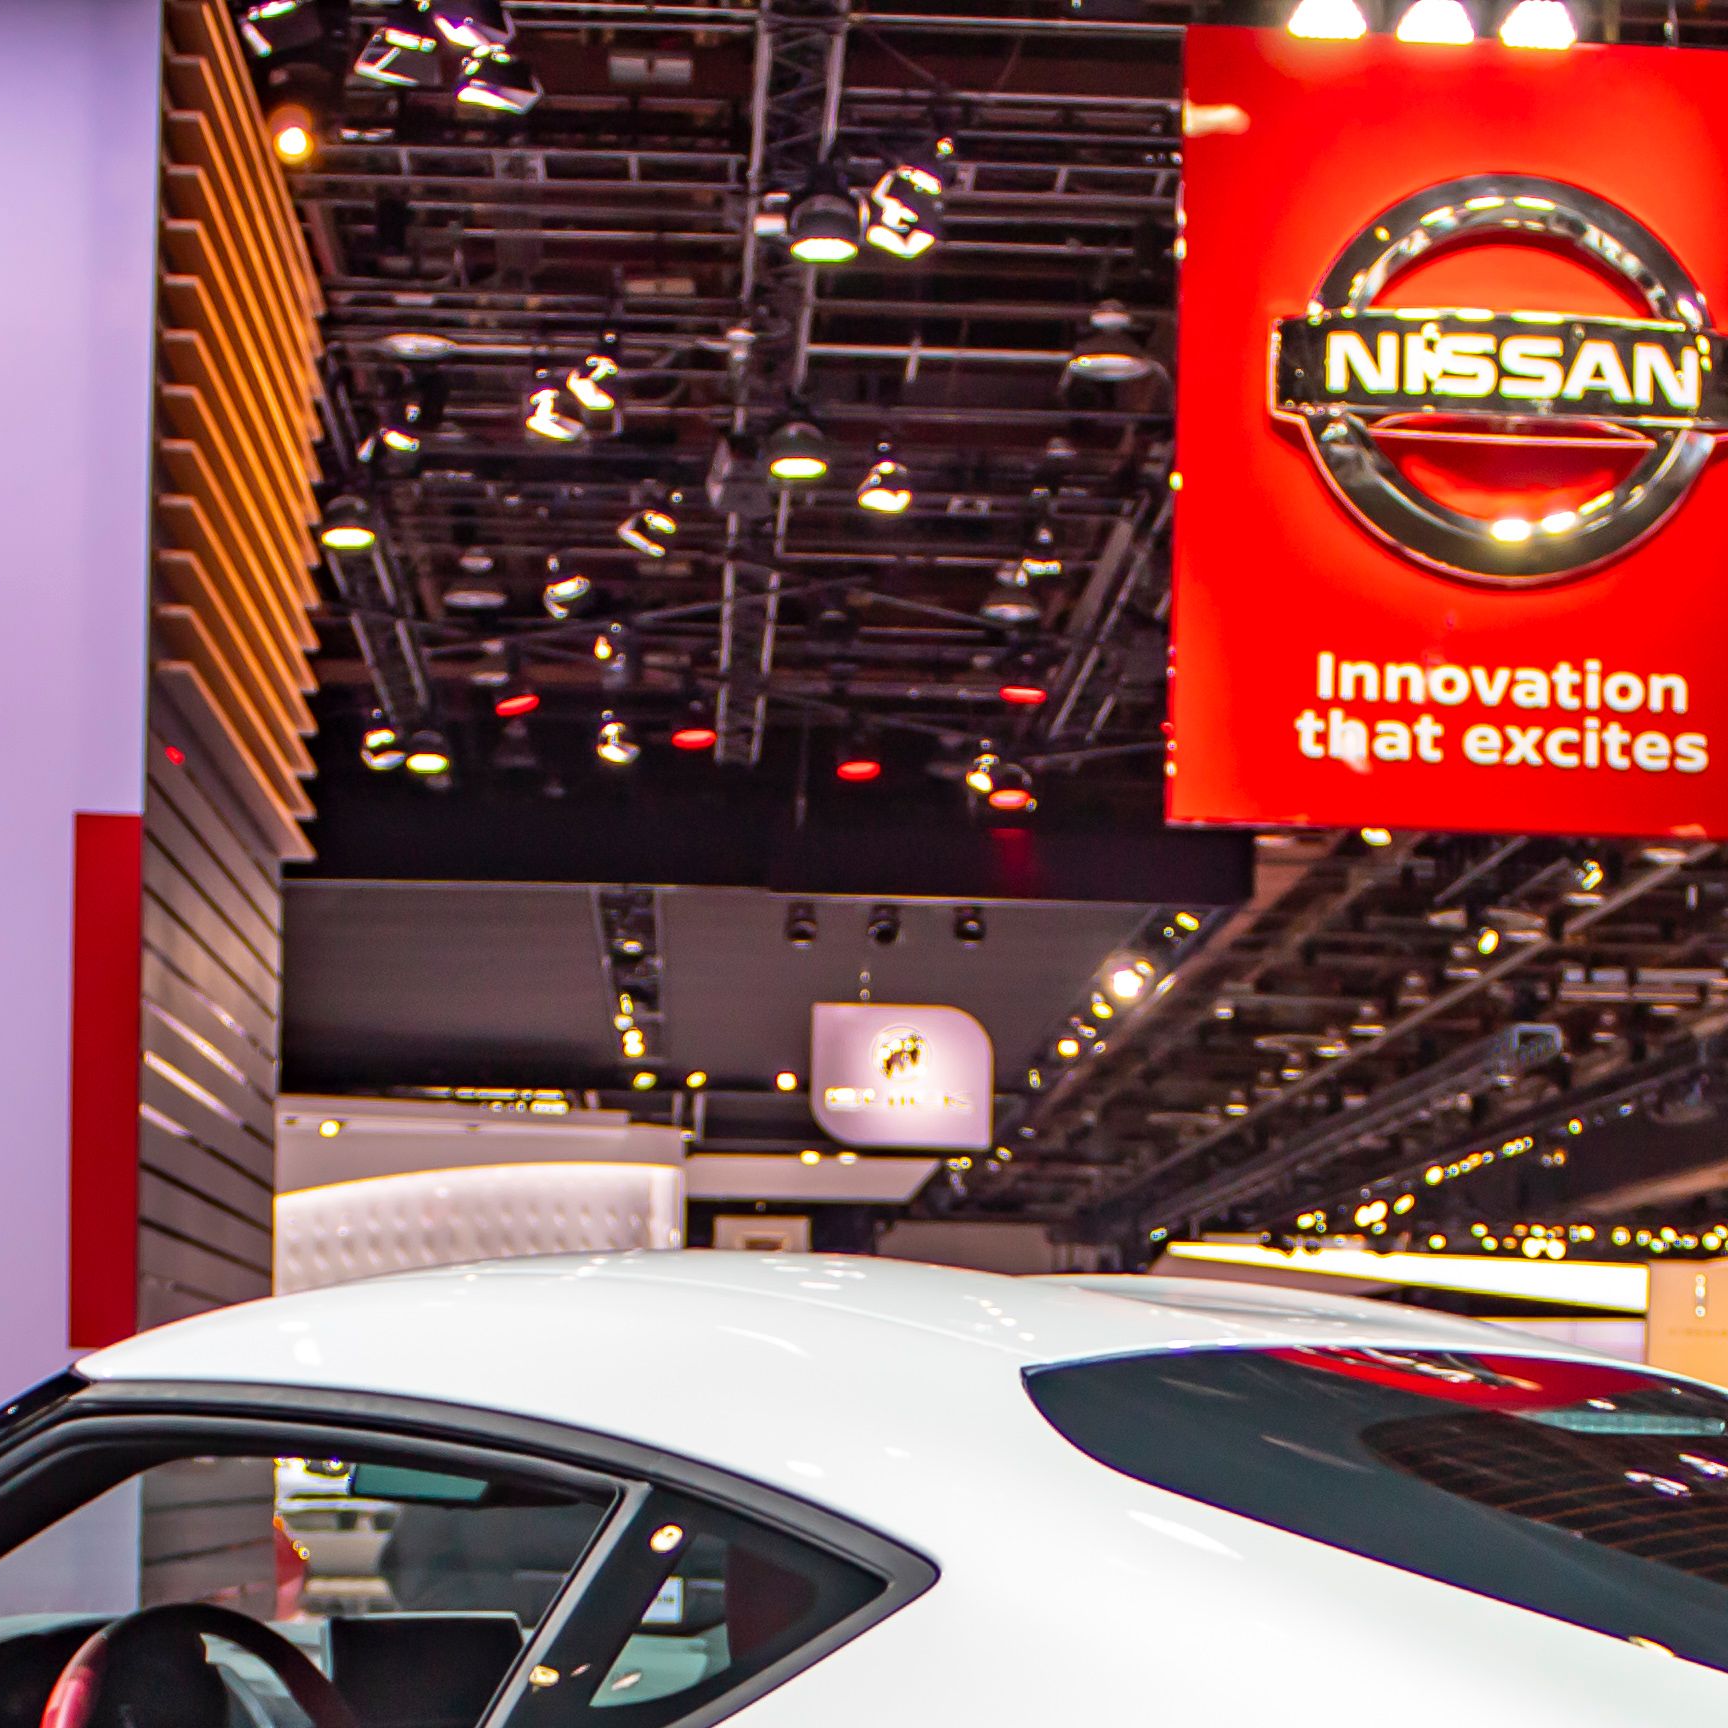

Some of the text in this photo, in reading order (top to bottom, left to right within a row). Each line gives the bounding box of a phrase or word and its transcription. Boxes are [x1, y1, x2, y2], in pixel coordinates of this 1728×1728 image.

[1325, 331, 1701, 409] NISSAN
[1317, 652, 1689, 714] Innovation
[1294, 707, 1710, 773] that excites
